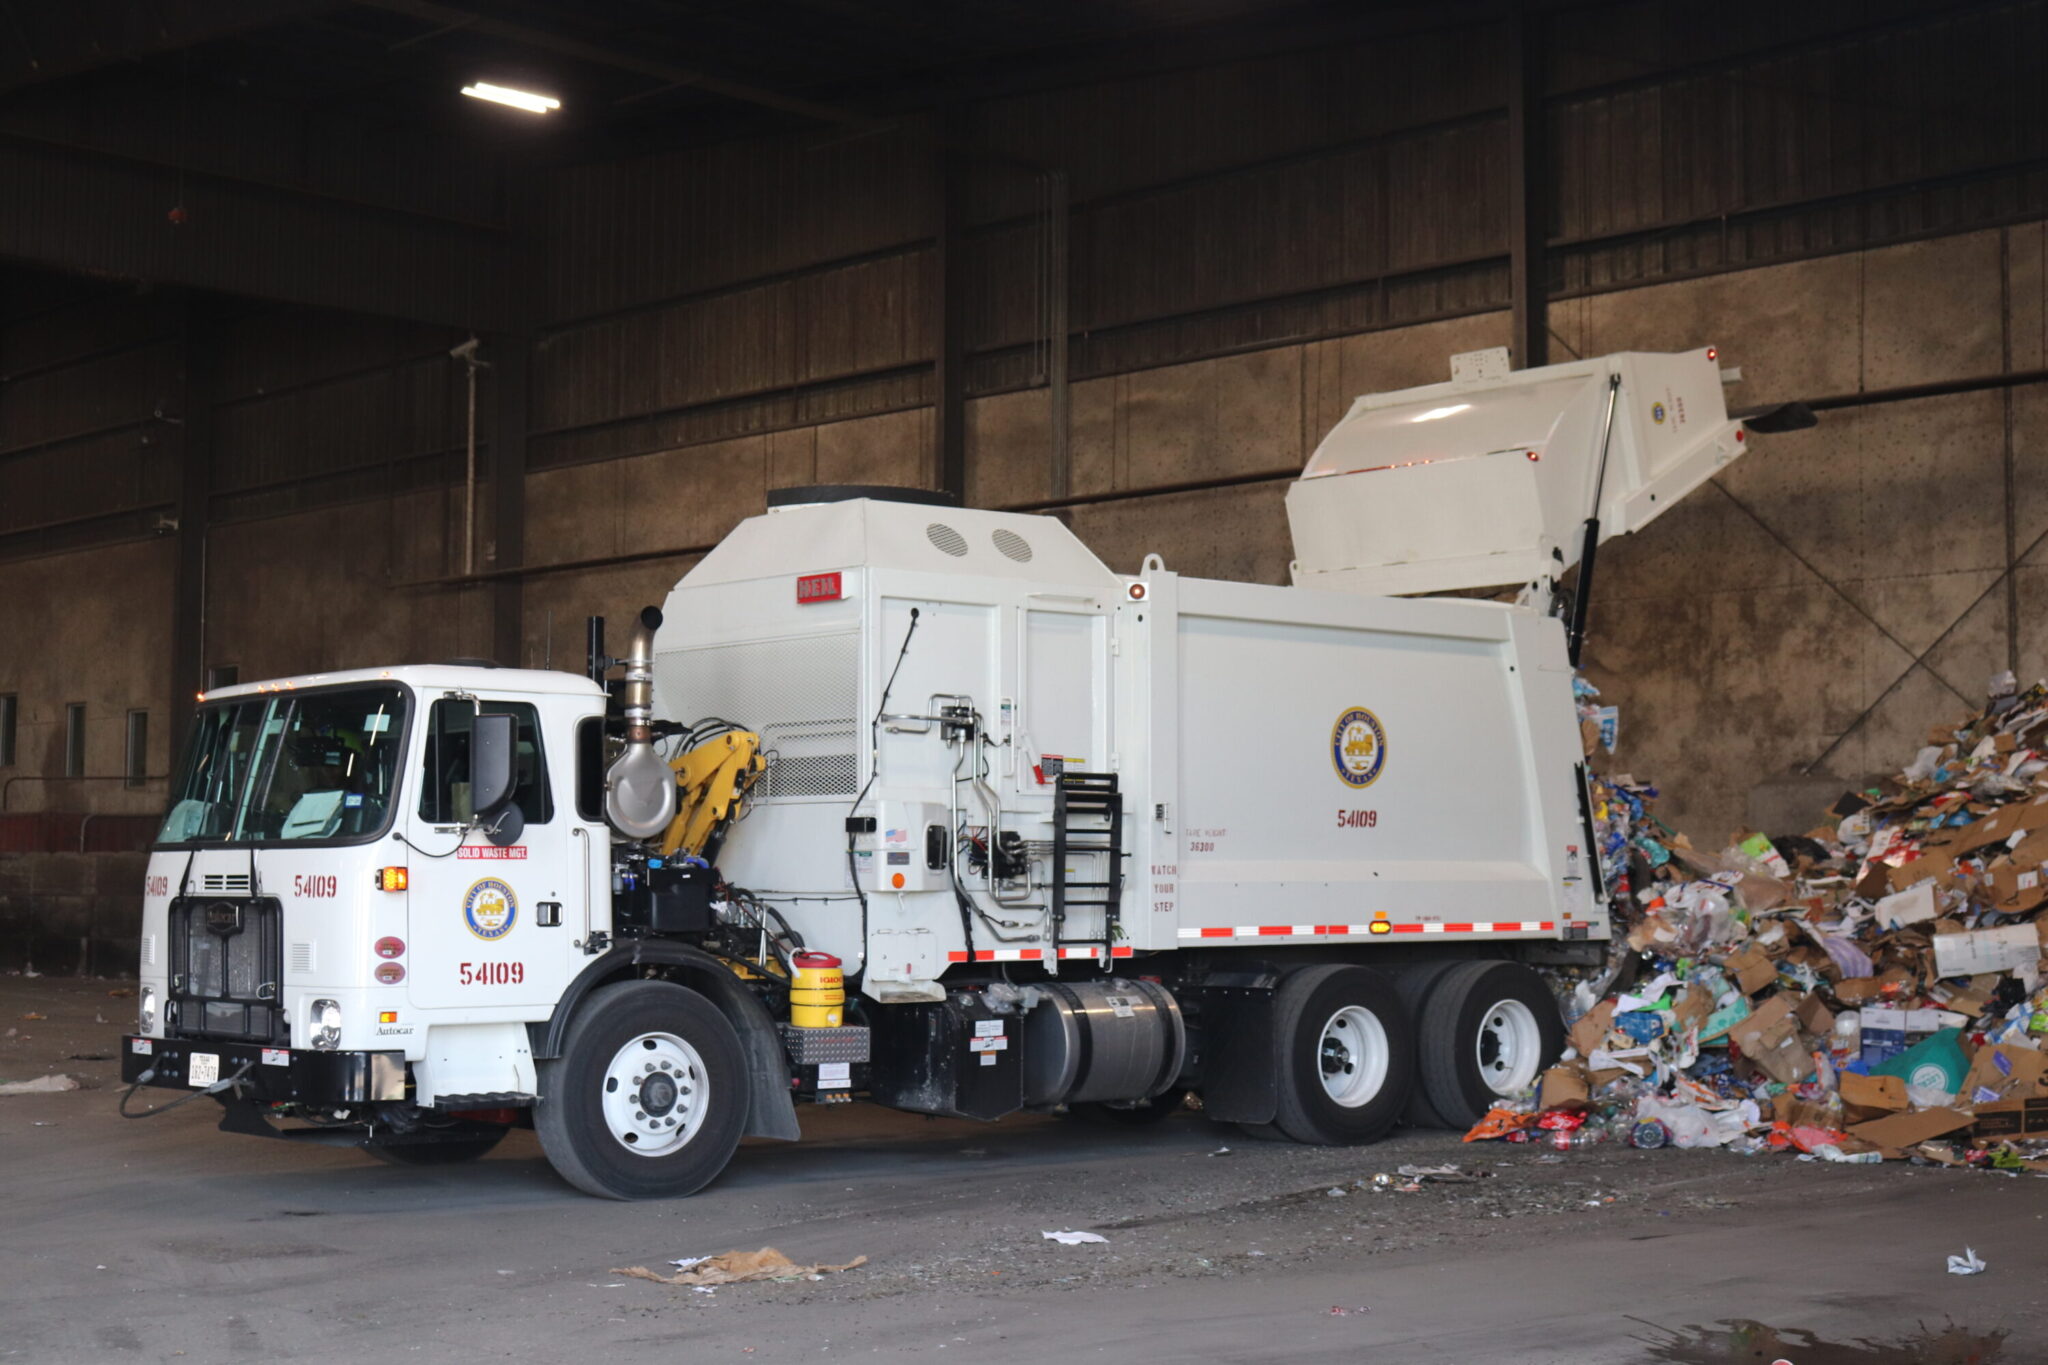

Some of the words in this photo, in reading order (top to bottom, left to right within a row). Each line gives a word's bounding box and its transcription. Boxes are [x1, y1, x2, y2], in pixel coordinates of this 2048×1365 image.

[799, 577, 838, 599] HEIL
[1337, 809, 1378, 828] 54109
[1190, 841, 1215, 852] 36300
[458, 847, 480, 859] SOLID
[482, 847, 508, 859] WASTE
[508, 847, 528, 859] MGT.
[1151, 865, 1177, 876] WATCH
[146, 876, 169, 897] 54109
[294, 874, 338, 899] 54109
[1154, 883, 1175, 894] YOUR
[1154, 902, 1175, 913] STEP
[460, 961, 524, 985] 54109
[376, 1026, 414, 1036] Autocar
